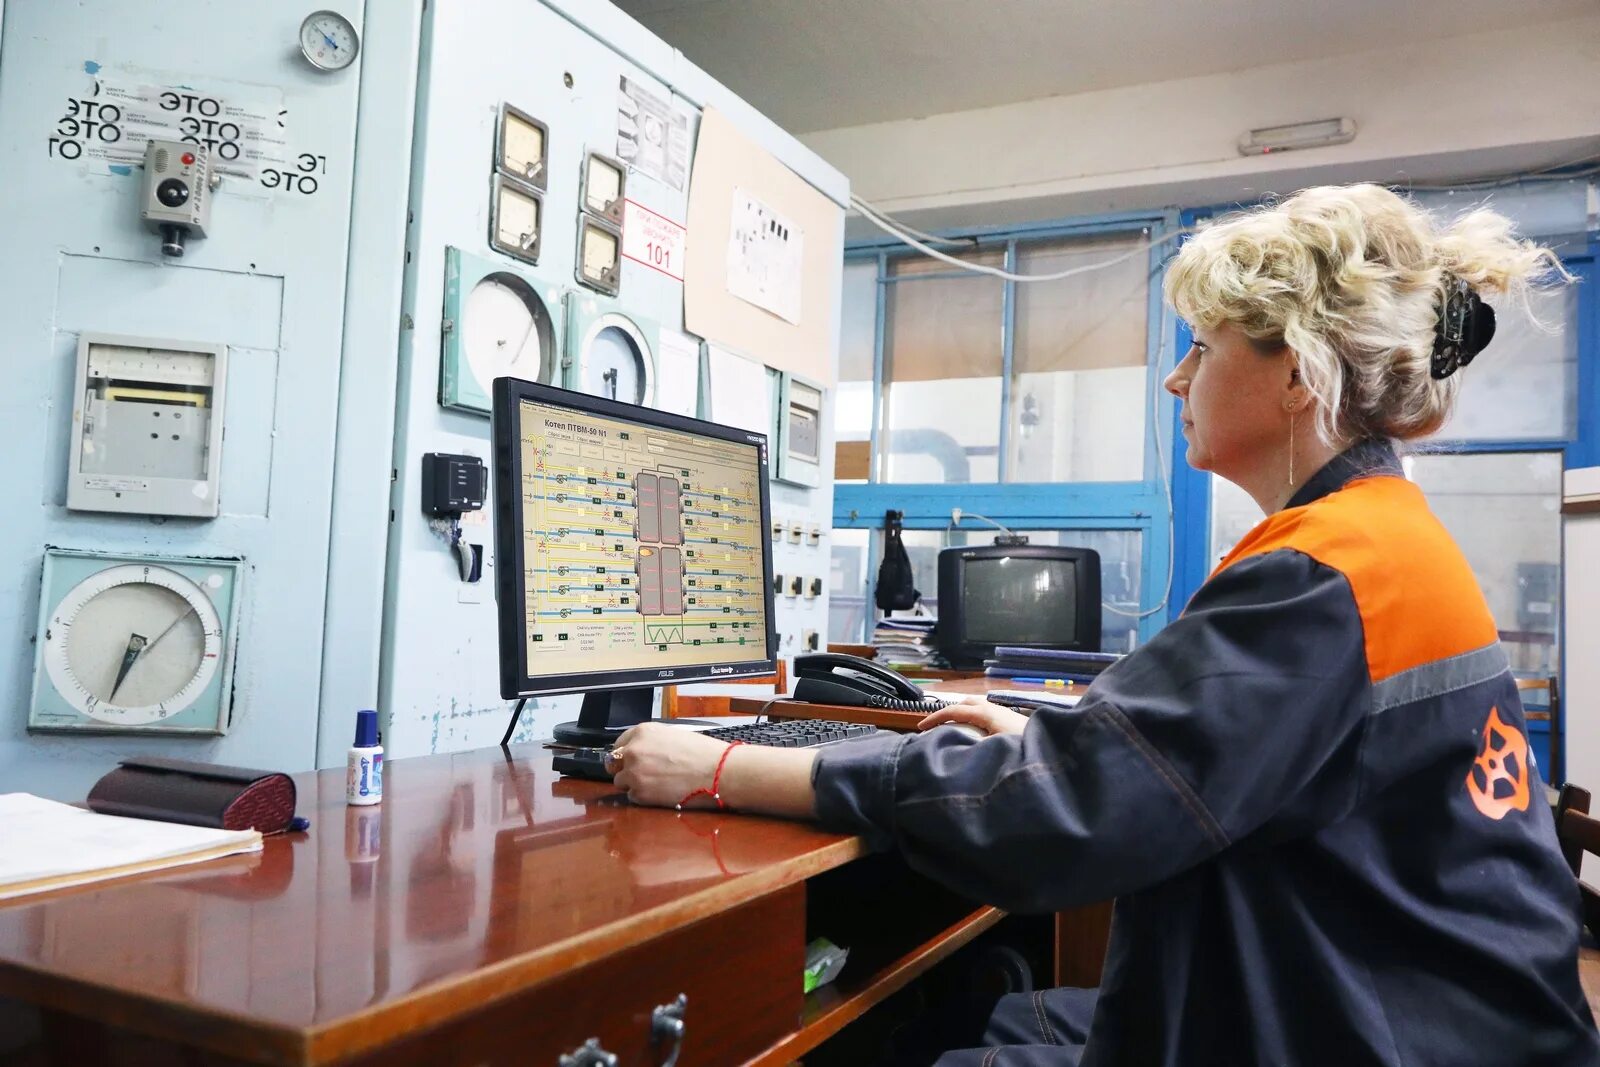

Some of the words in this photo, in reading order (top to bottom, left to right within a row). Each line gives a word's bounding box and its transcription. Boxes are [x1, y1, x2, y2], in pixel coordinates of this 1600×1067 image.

[65, 98, 120, 123] ЭТО
[159, 92, 219, 117] ЭТО
[57, 117, 120, 142] ЭТО
[180, 117, 239, 141] ЭТО
[180, 136, 239, 160] ТО
[261, 168, 318, 195] ЭТО
[647, 242, 670, 268] 101
[544, 419, 566, 430] Котел
[567, 424, 597, 436] ПТВМ-50
[598, 429, 607, 437] N1
[143, 567, 150, 575] 8
[213, 629, 222, 637] 12
